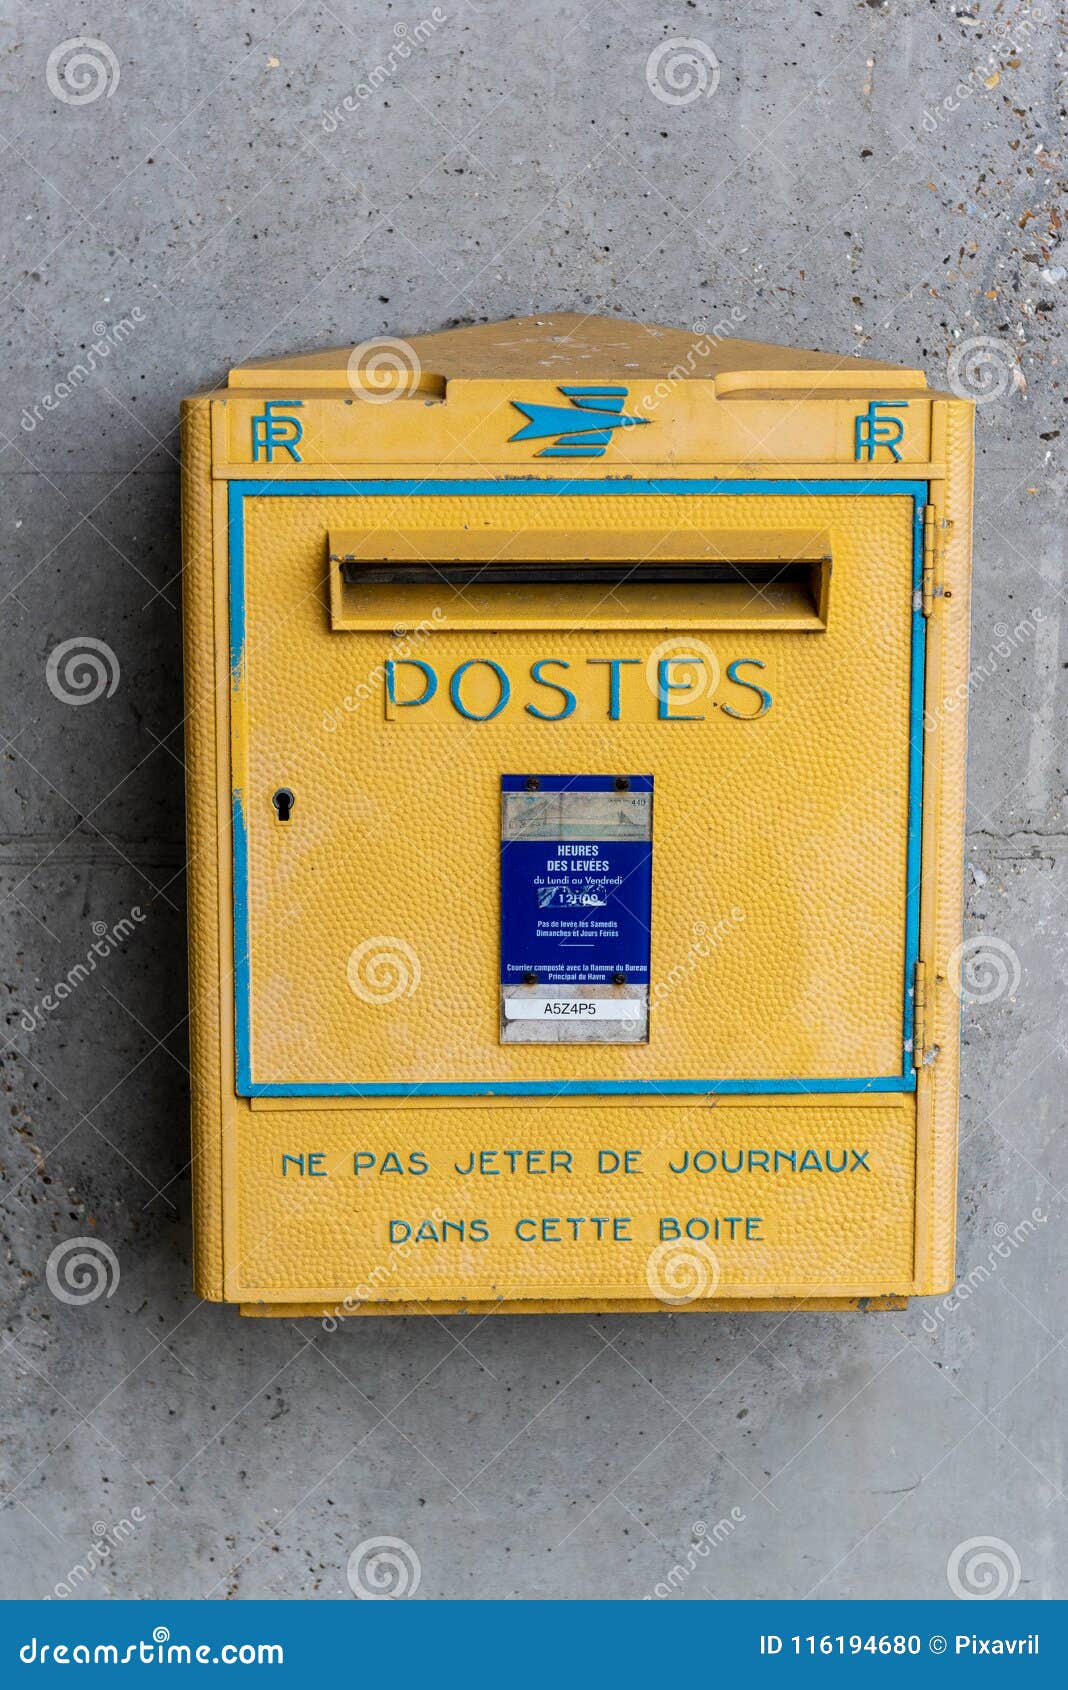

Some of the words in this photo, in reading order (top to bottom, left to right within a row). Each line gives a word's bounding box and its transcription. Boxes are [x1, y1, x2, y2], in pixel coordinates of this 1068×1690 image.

[384, 658, 773, 721] POSTES
[557, 845, 599, 856] HEURES
[546, 860, 568, 871] DES
[570, 858, 610, 871] LEVÉES
[533, 876, 545, 884] du
[547, 876, 570, 885] Lundi
[585, 876, 623, 885] Vendredi
[537, 920, 550, 928] Pas
[550, 920, 559, 928] de
[590, 920, 618, 928] Samedis
[536, 929, 572, 937] Dimanches
[580, 929, 598, 937] Jours
[548, 973, 577, 981] Principal
[543, 1003, 597, 1015] A5Z4P5
[282, 1152, 328, 1176] NE
[353, 1151, 430, 1176] PAS
[455, 1150, 573, 1175] JETER
[598, 1150, 643, 1174] DE
[669, 1149, 871, 1174] JOURNAUX
[389, 1219, 490, 1243] DANS
[515, 1218, 633, 1242] CETTE
[659, 1217, 764, 1241] BOITE
